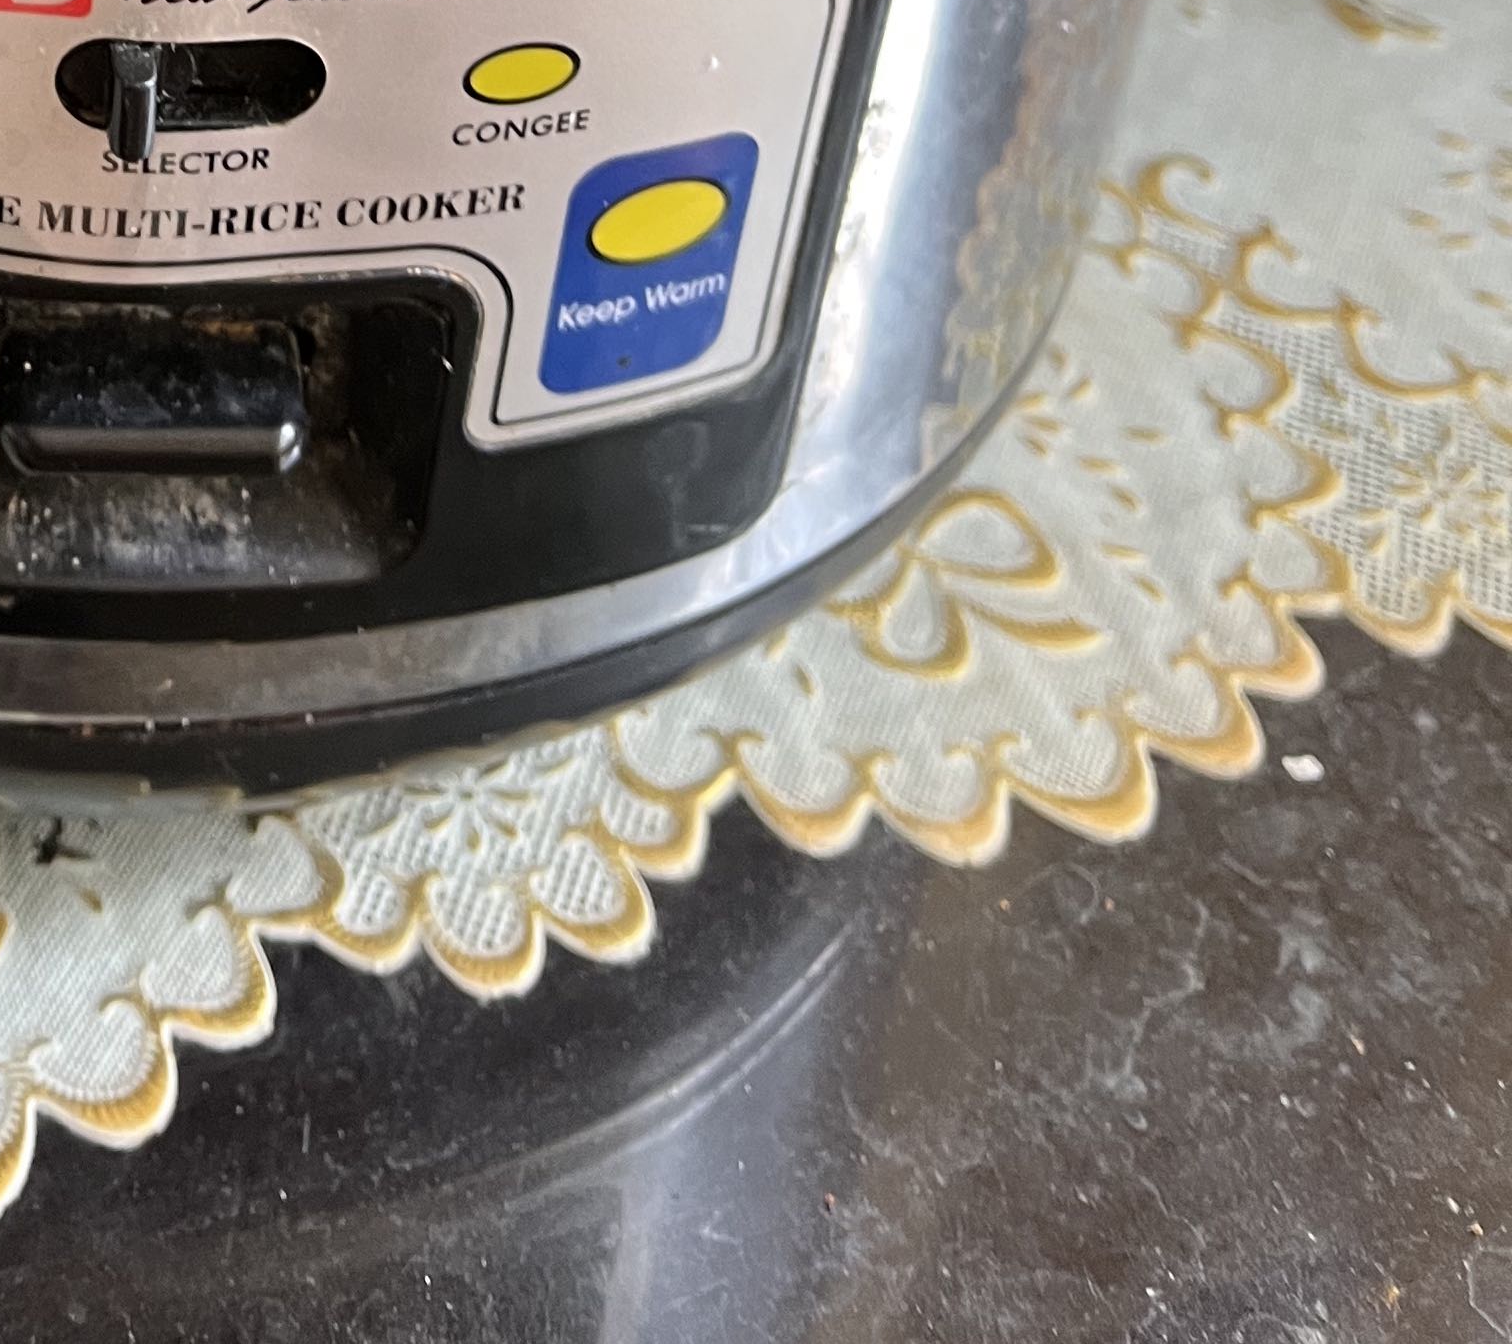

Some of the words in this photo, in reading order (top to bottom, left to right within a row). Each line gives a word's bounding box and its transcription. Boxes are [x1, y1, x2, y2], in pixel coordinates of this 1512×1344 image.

[452, 109, 591, 146] CONGEE
[37, 199, 322, 239] MULTI-RICE
[336, 183, 526, 225] COOKER
[556, 295, 637, 332] Keep
[644, 273, 726, 311] Warm
